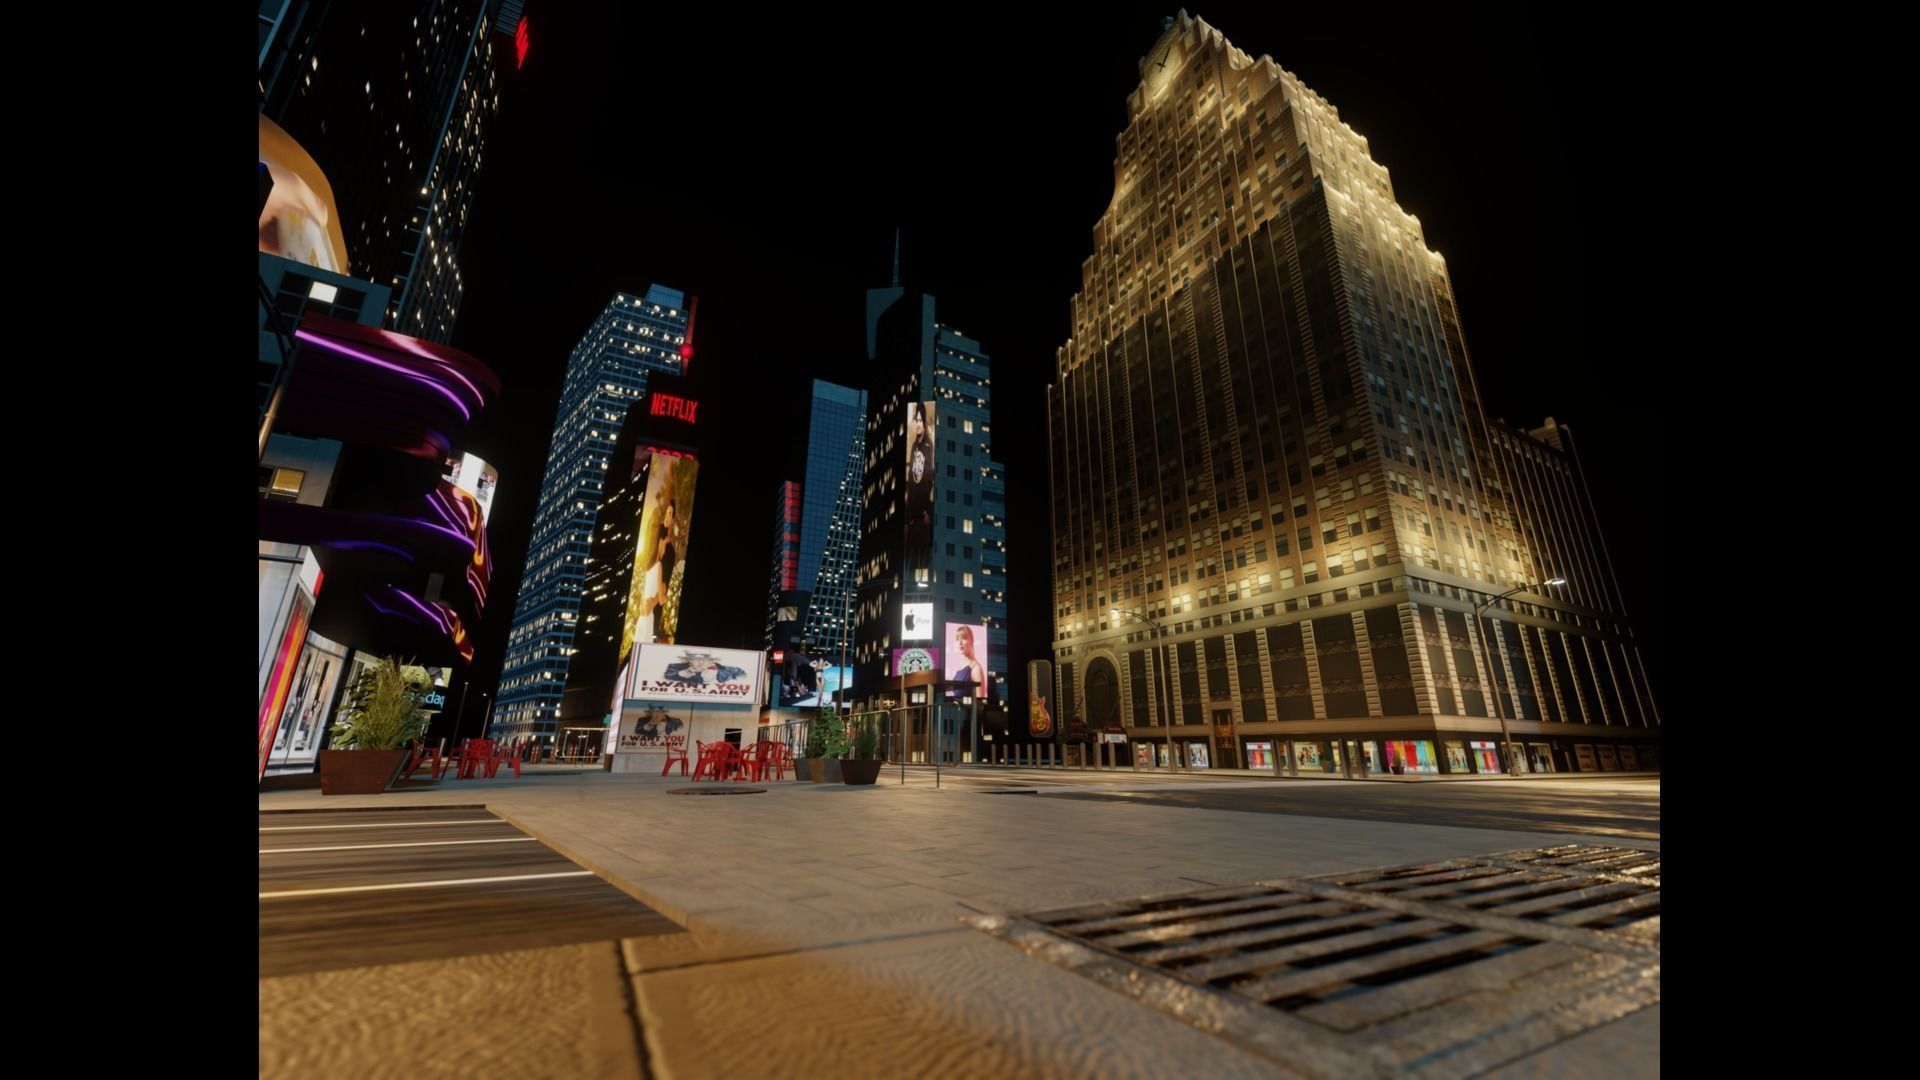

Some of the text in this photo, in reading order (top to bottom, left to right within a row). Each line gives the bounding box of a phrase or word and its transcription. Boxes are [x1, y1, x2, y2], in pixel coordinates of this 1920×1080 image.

[650, 392, 698, 423] NETFLIX
[655, 681, 710, 689] WANT
[715, 683, 750, 691] YOU
